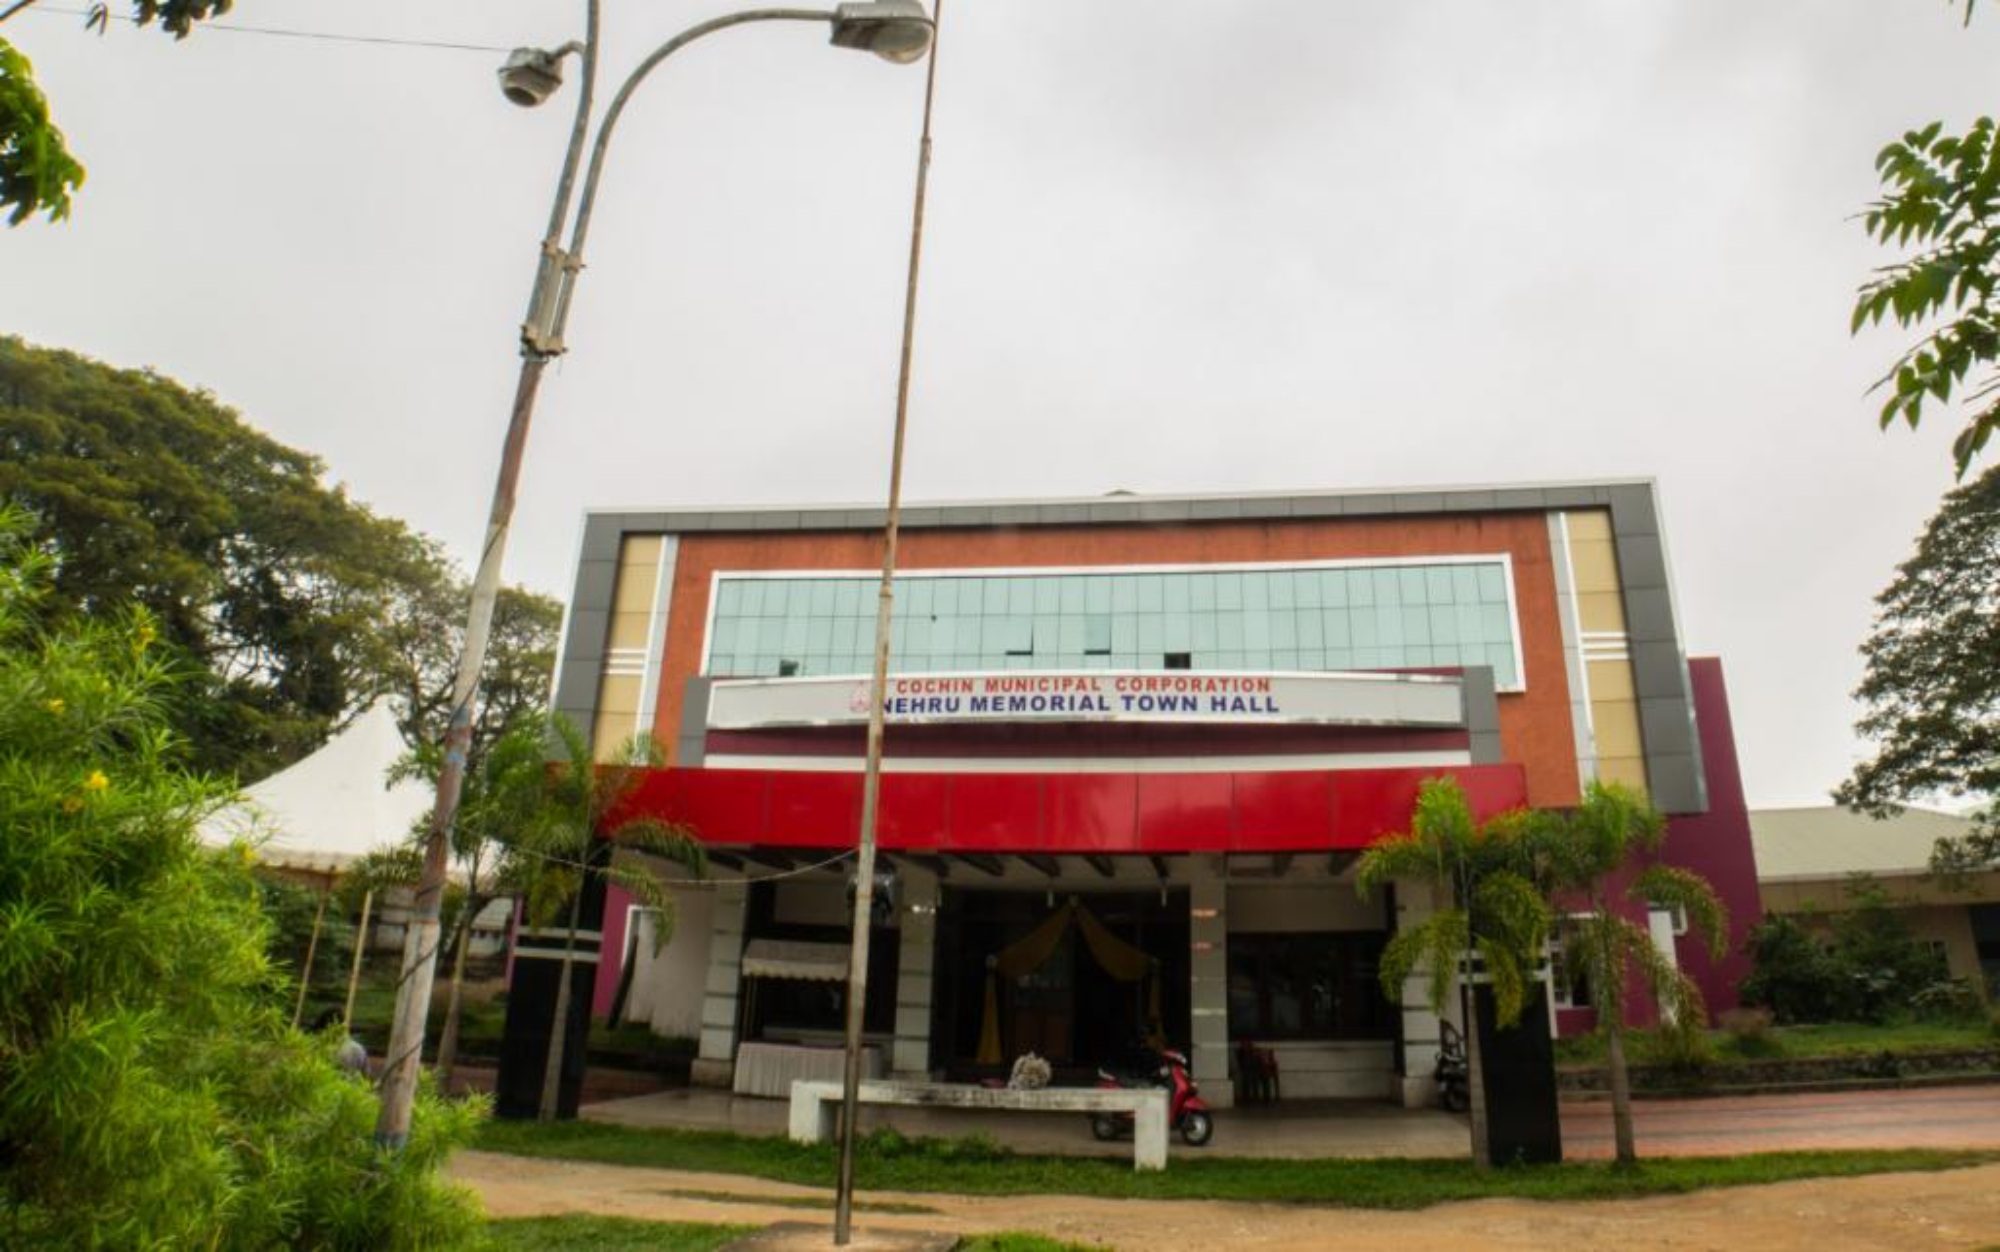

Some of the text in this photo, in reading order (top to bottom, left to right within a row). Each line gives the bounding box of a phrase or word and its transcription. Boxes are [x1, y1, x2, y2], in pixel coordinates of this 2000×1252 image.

[896, 677, 1271, 694] COCHIN MUNICIPAL CORPORATION
[970, 696, 1111, 712] MEMORIAL
[1121, 695, 1198, 712] TOWN
[1210, 696, 1280, 712] HALL
